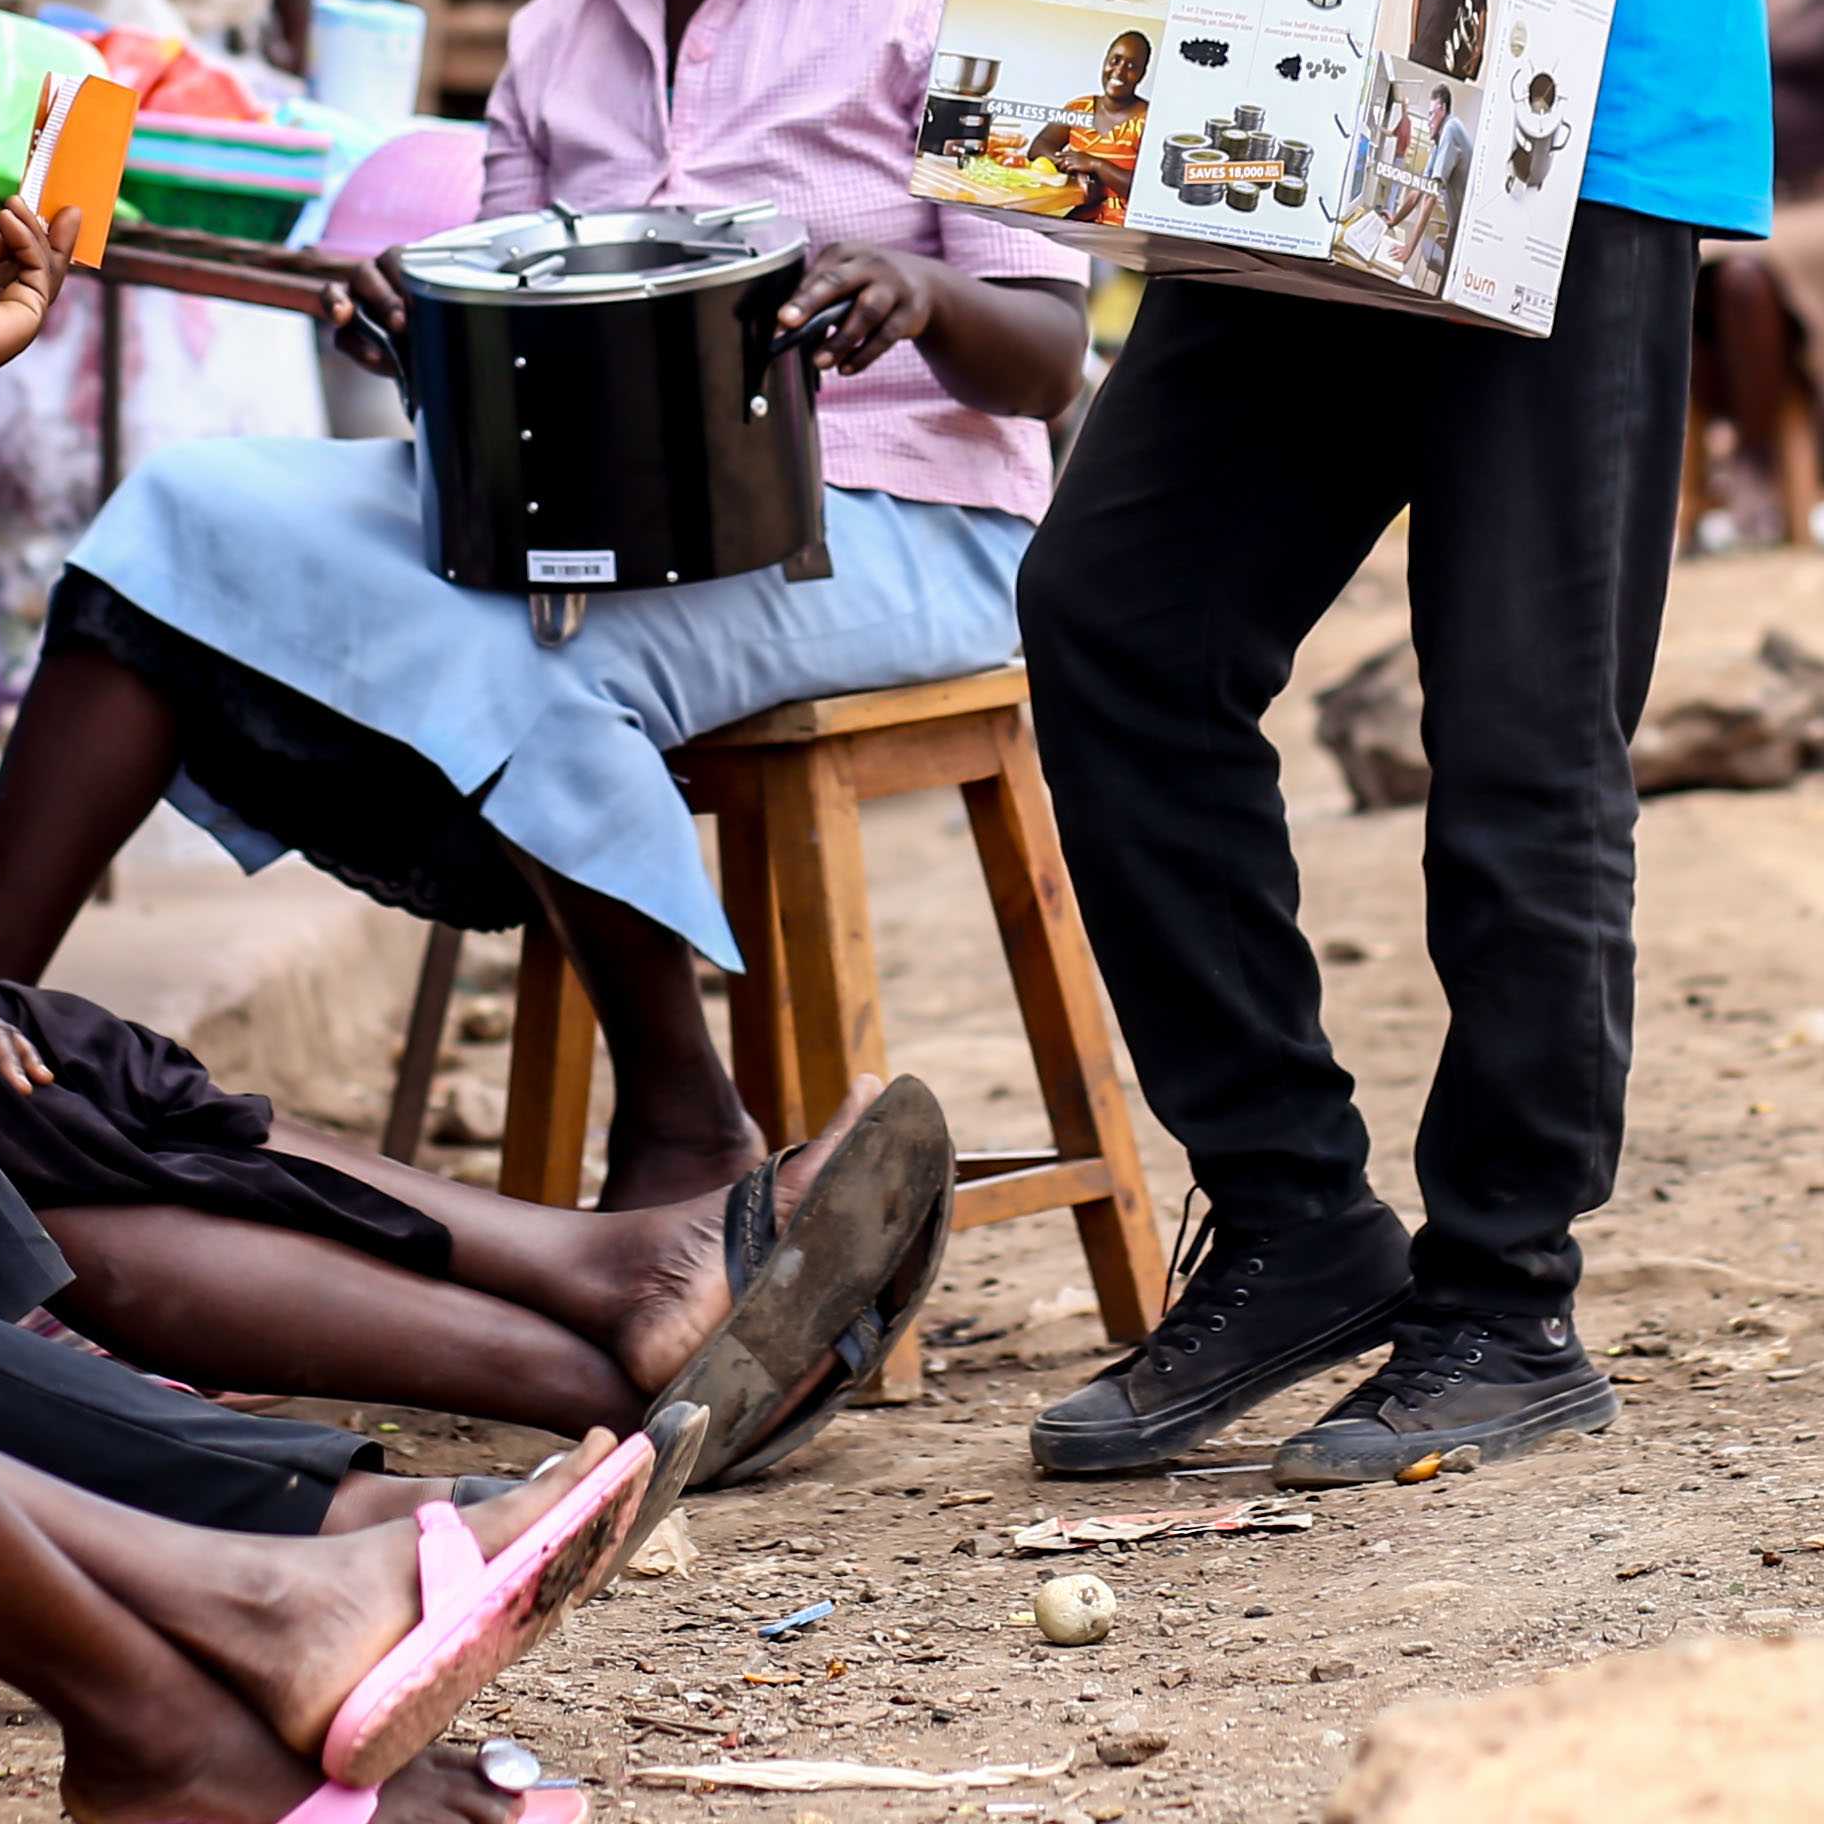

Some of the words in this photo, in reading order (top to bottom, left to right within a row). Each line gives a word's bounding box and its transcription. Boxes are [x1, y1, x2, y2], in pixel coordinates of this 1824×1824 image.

[987, 100, 1014, 116] 64%
[1015, 105, 1046, 120] LESS
[1047, 110, 1095, 127] SMOKE
[1188, 167, 1226, 180] SAVES
[1228, 166, 1264, 180] 18,000
[1376, 161, 1413, 186] DESIGNED
[1463, 265, 1497, 297] burn
